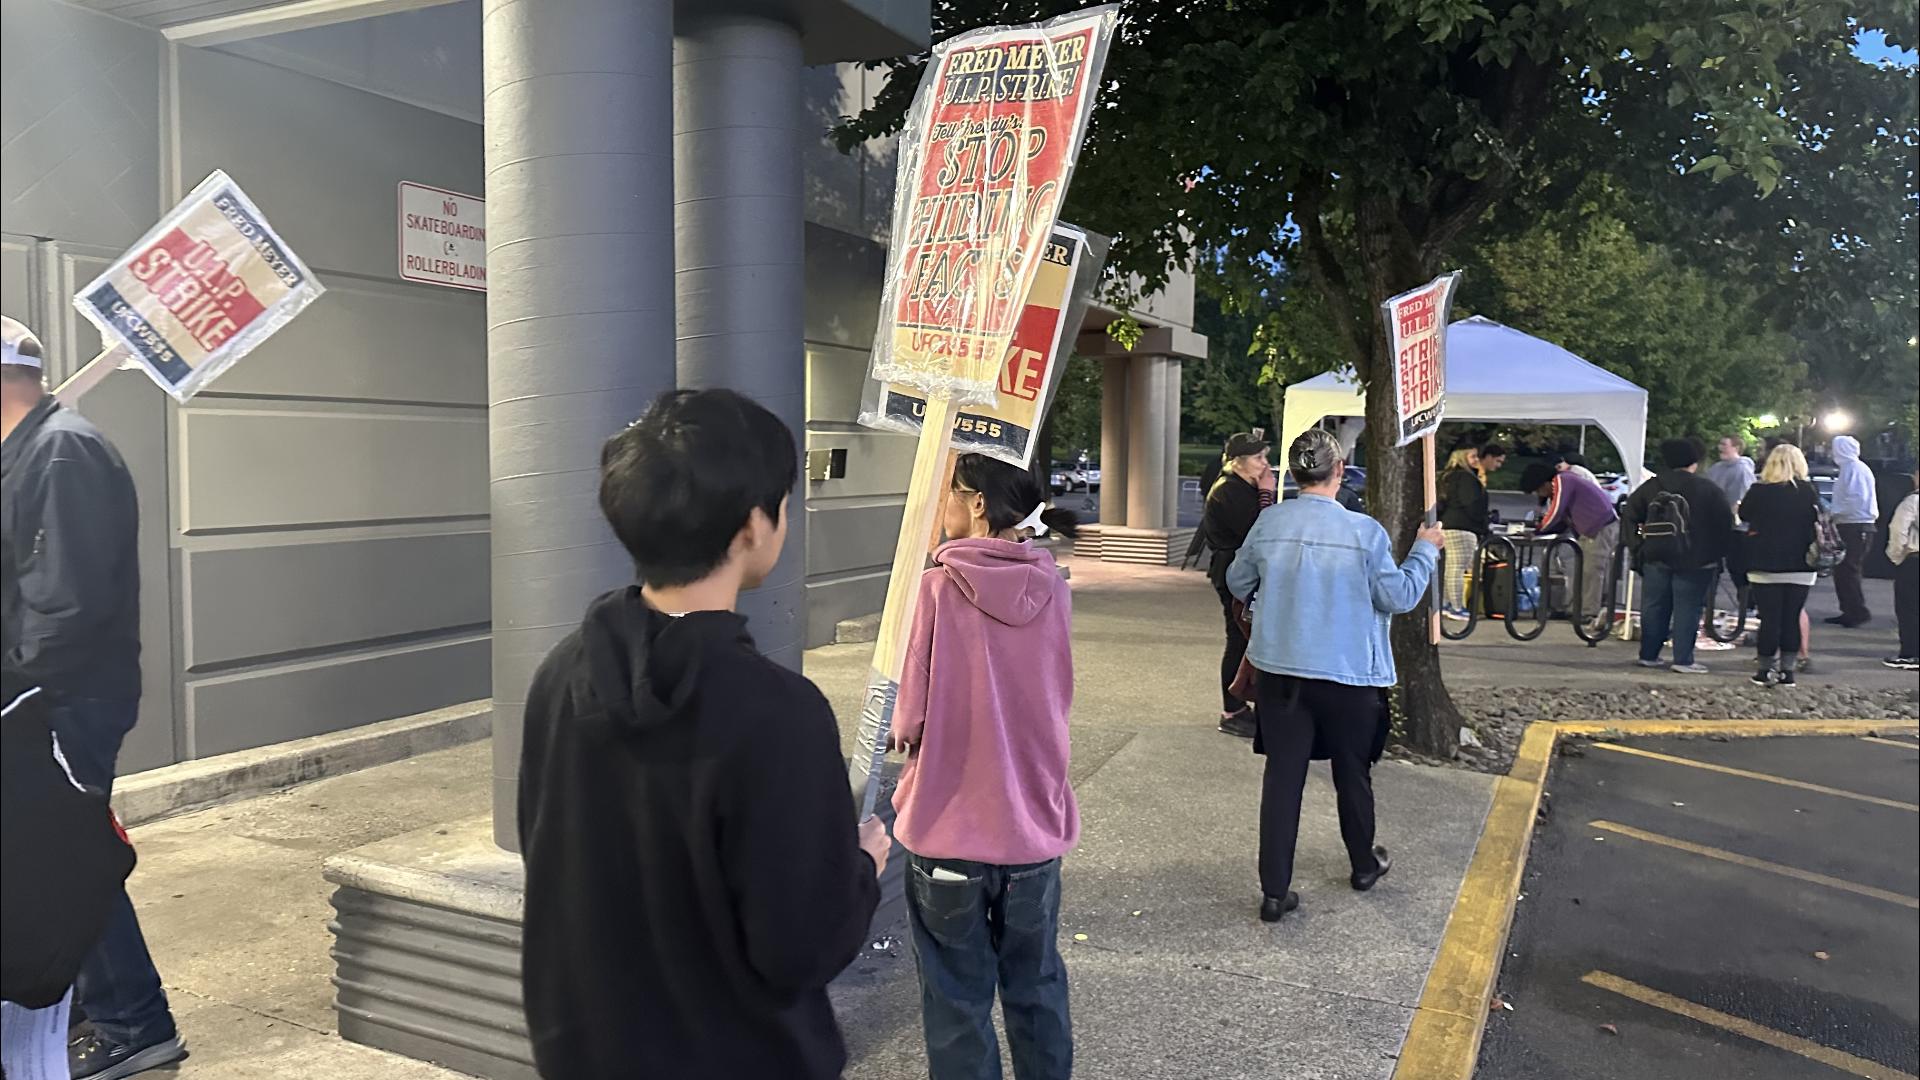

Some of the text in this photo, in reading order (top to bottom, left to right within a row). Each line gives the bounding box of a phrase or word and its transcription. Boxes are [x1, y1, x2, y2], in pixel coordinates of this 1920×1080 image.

[946, 48, 1003, 76] FRED
[932, 122, 957, 142] Tell
[938, 126, 1046, 186] STOP
[443, 200, 458, 217] NO
[406, 213, 486, 241] SKATEBOARDIN
[406, 254, 487, 280] ROLLERBLADIN
[910, 246, 1025, 300] FACS
[130, 247, 239, 352] STRIKE
[1397, 301, 1423, 319] FRED
